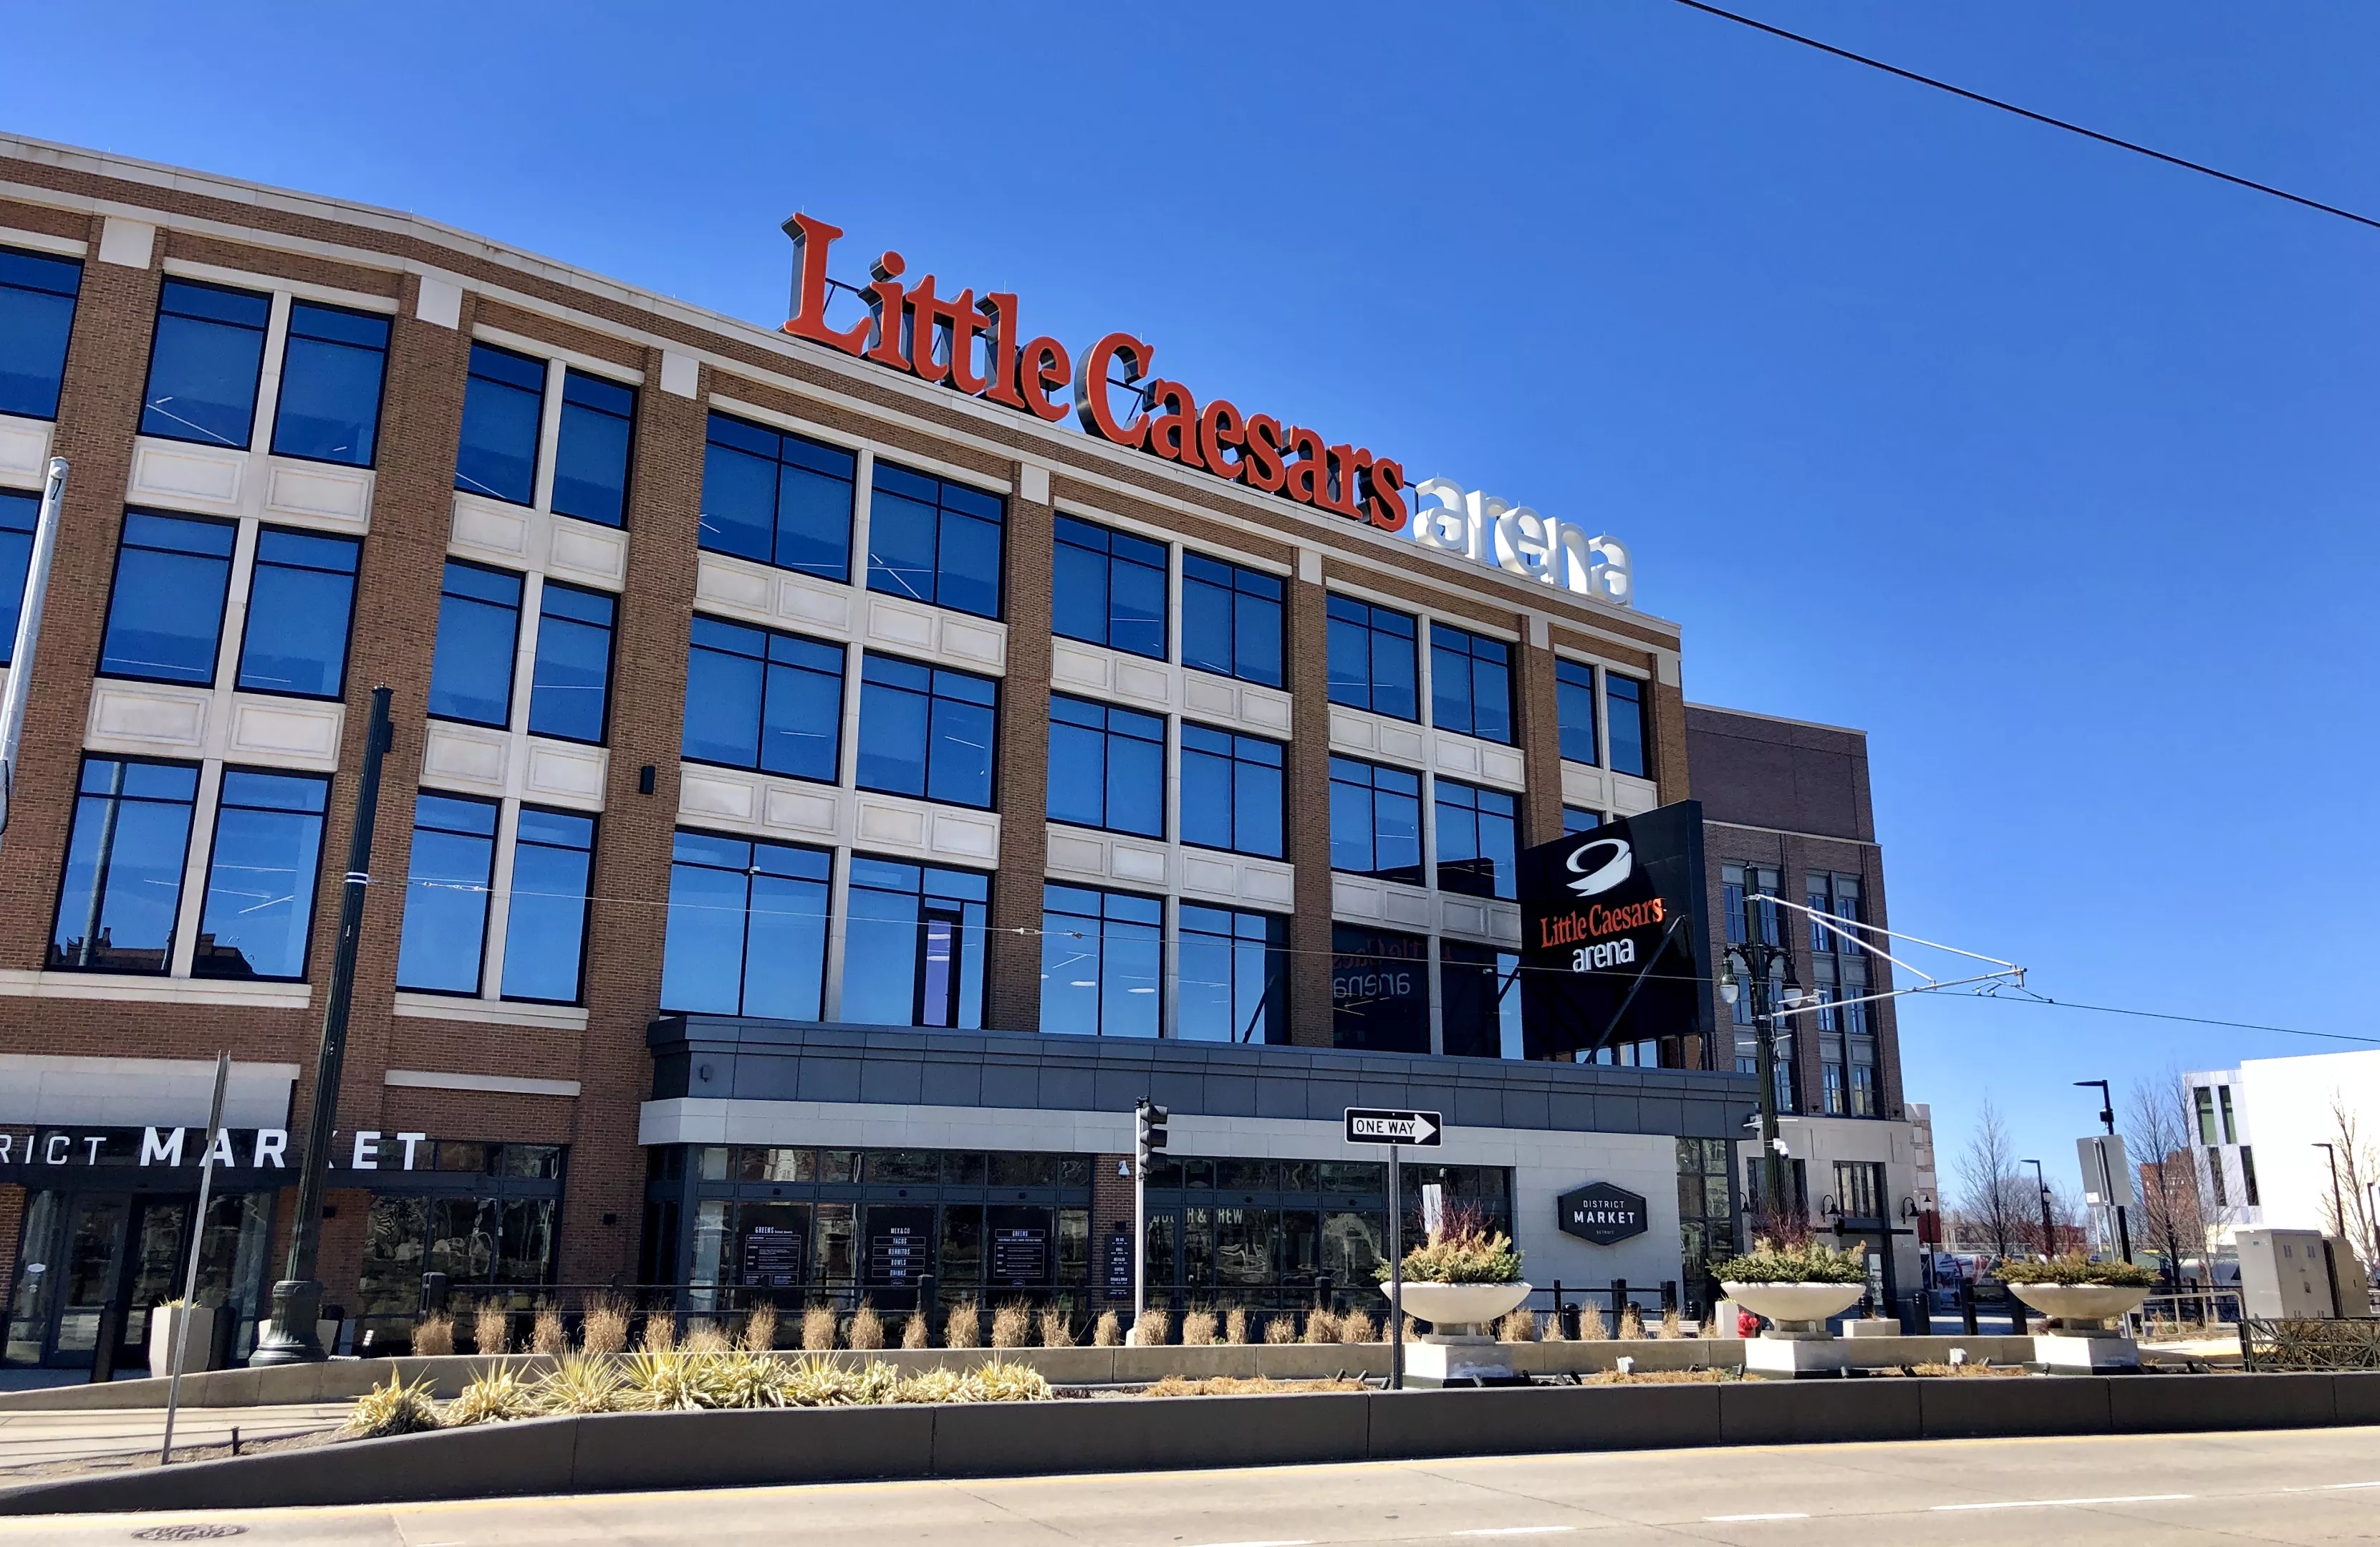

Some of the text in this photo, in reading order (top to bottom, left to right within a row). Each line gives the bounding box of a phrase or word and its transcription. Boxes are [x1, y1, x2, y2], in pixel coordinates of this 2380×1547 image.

[781, 212, 1634, 608] Little Caesars arena
[1540, 897, 1664, 948] Little Caesars
[1572, 938, 1635, 973] arena
[1357, 1119, 1415, 1134] ONE WAY
[140, 1127, 425, 1170] MARET
[1574, 1210, 1634, 1224] MARKET
[1583, 1200, 1624, 1208] DISTRICT
